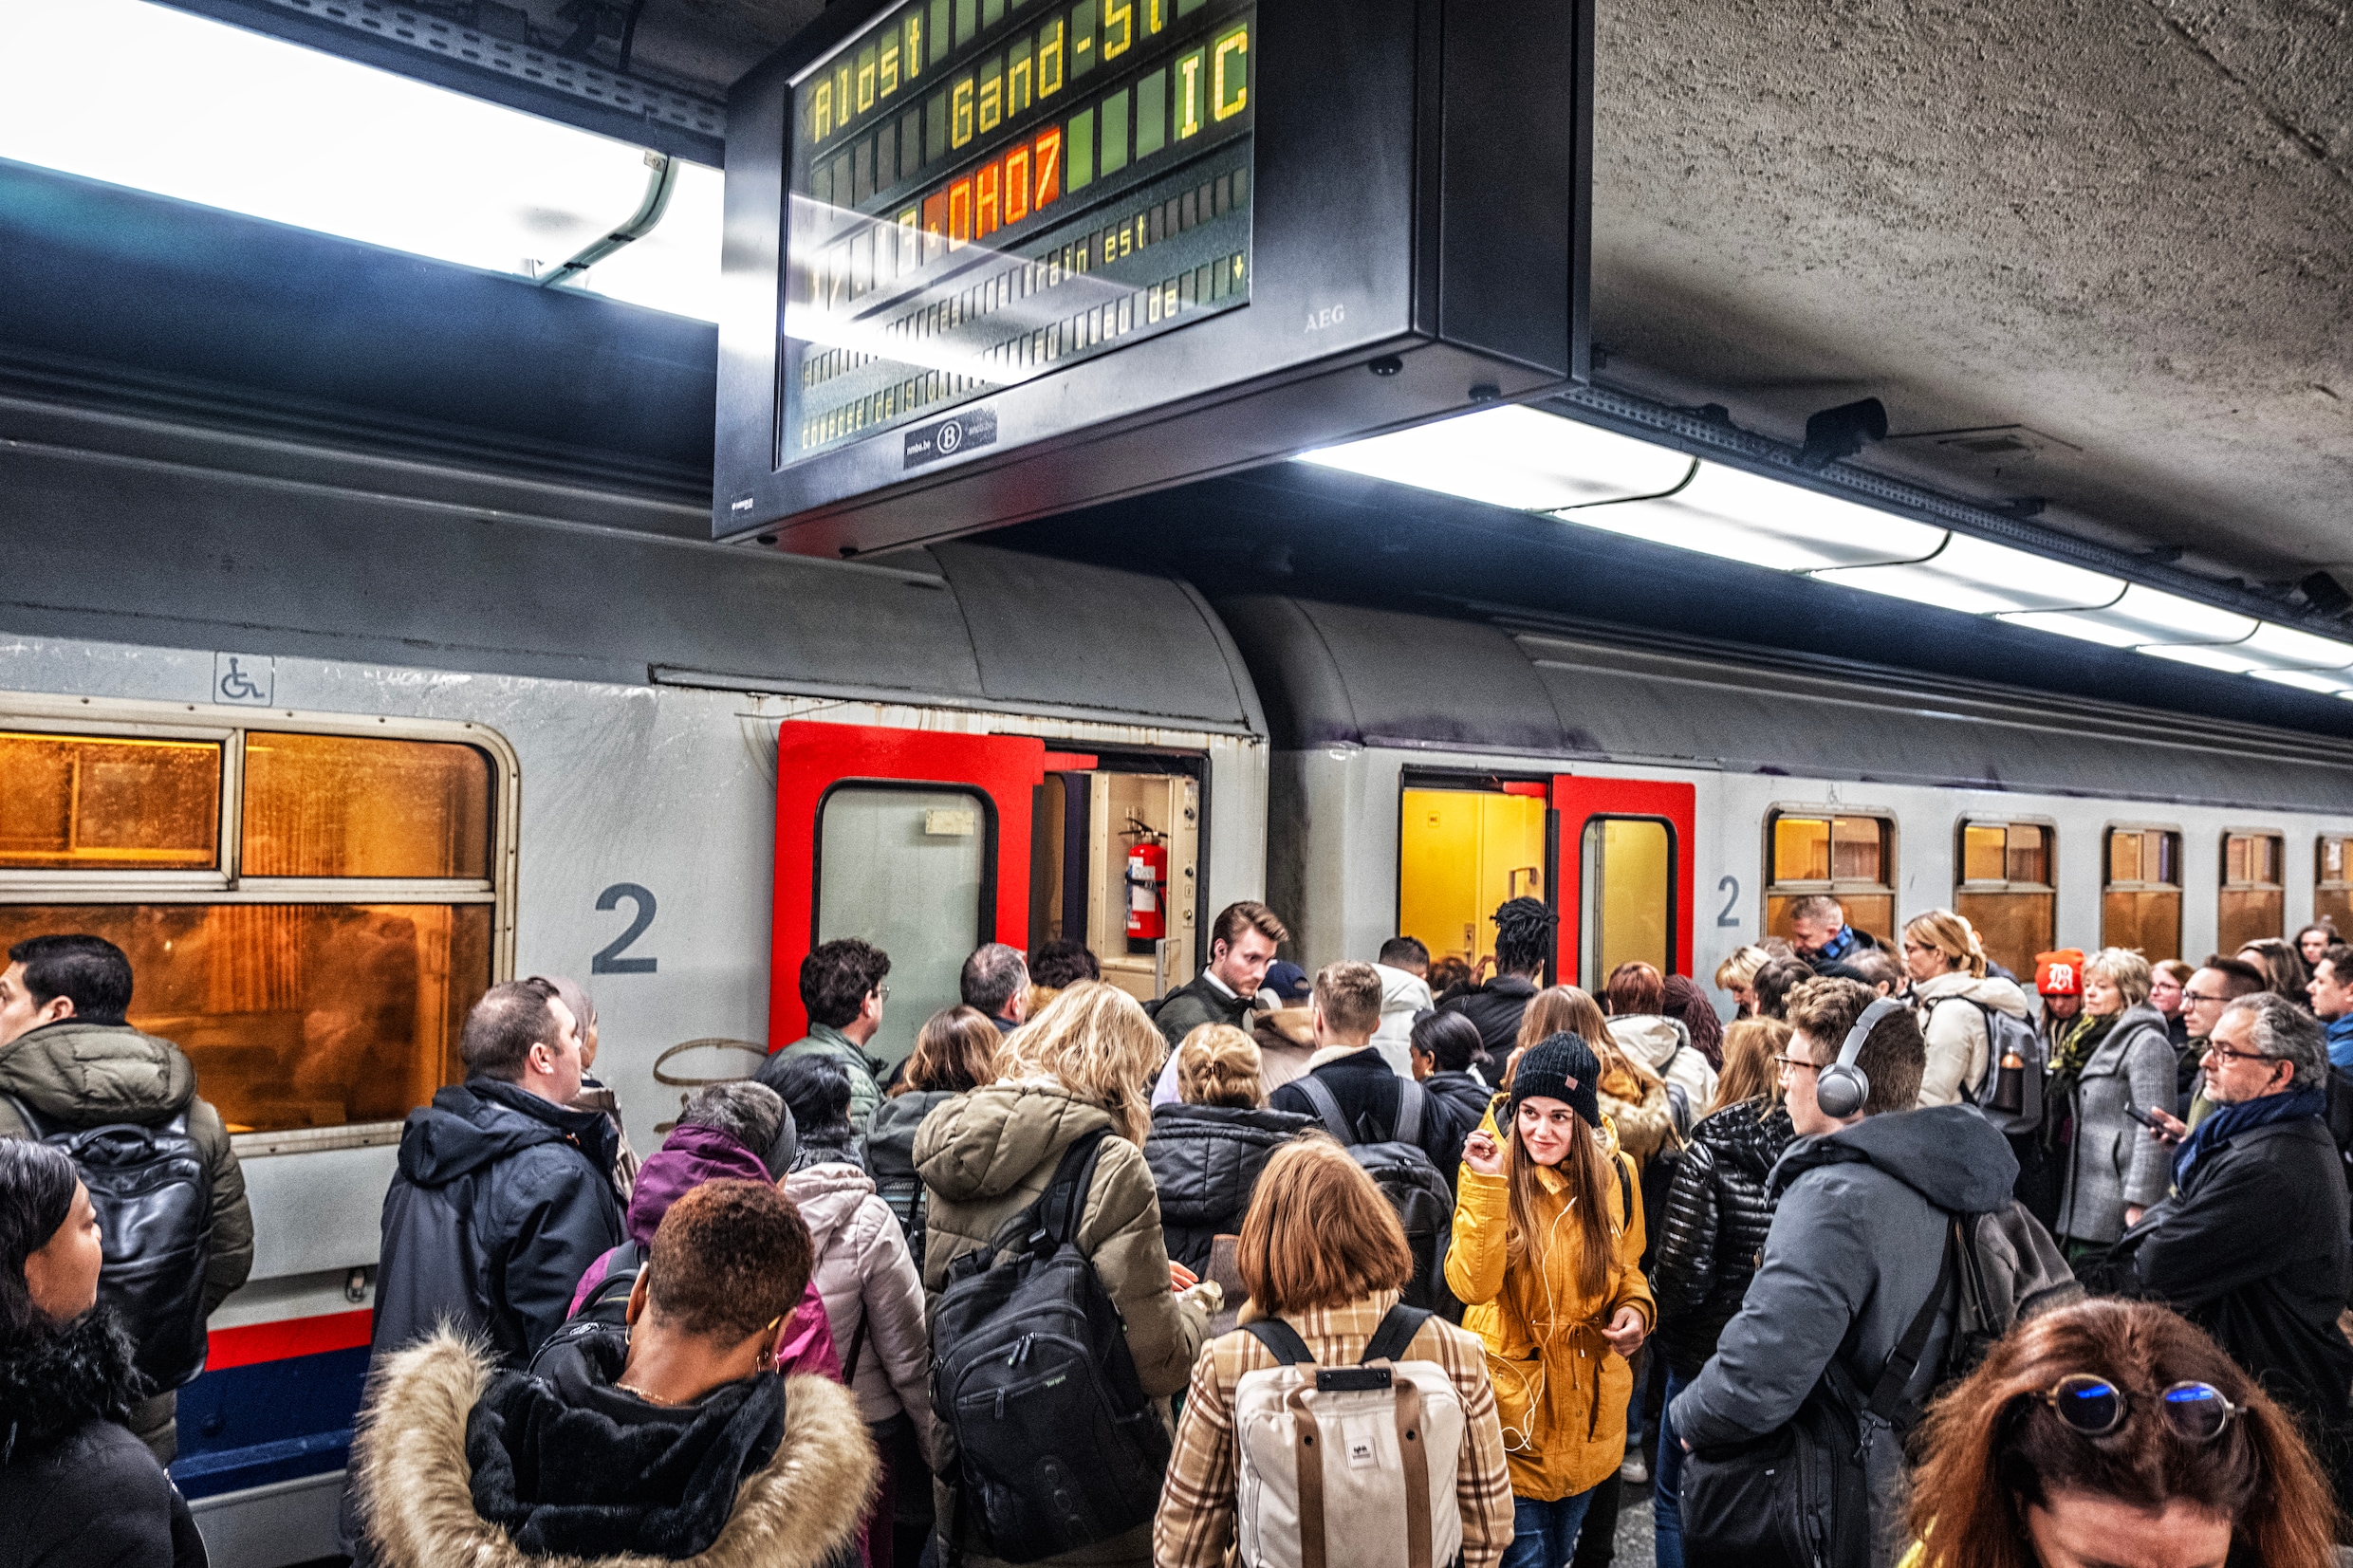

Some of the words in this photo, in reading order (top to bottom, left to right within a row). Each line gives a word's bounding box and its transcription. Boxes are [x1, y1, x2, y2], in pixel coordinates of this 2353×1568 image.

[814, 16, 920, 144] Alost
[1181, 30, 1248, 139] IC
[1024, 247, 1087, 297] train
[1104, 214, 1144, 264] est
[1076, 305, 1129, 350] lieu
[1148, 286, 1176, 324] de
[1305, 304, 1344, 333] AEG
[592, 882, 658, 974] 2
[1717, 875, 1739, 927] 2
